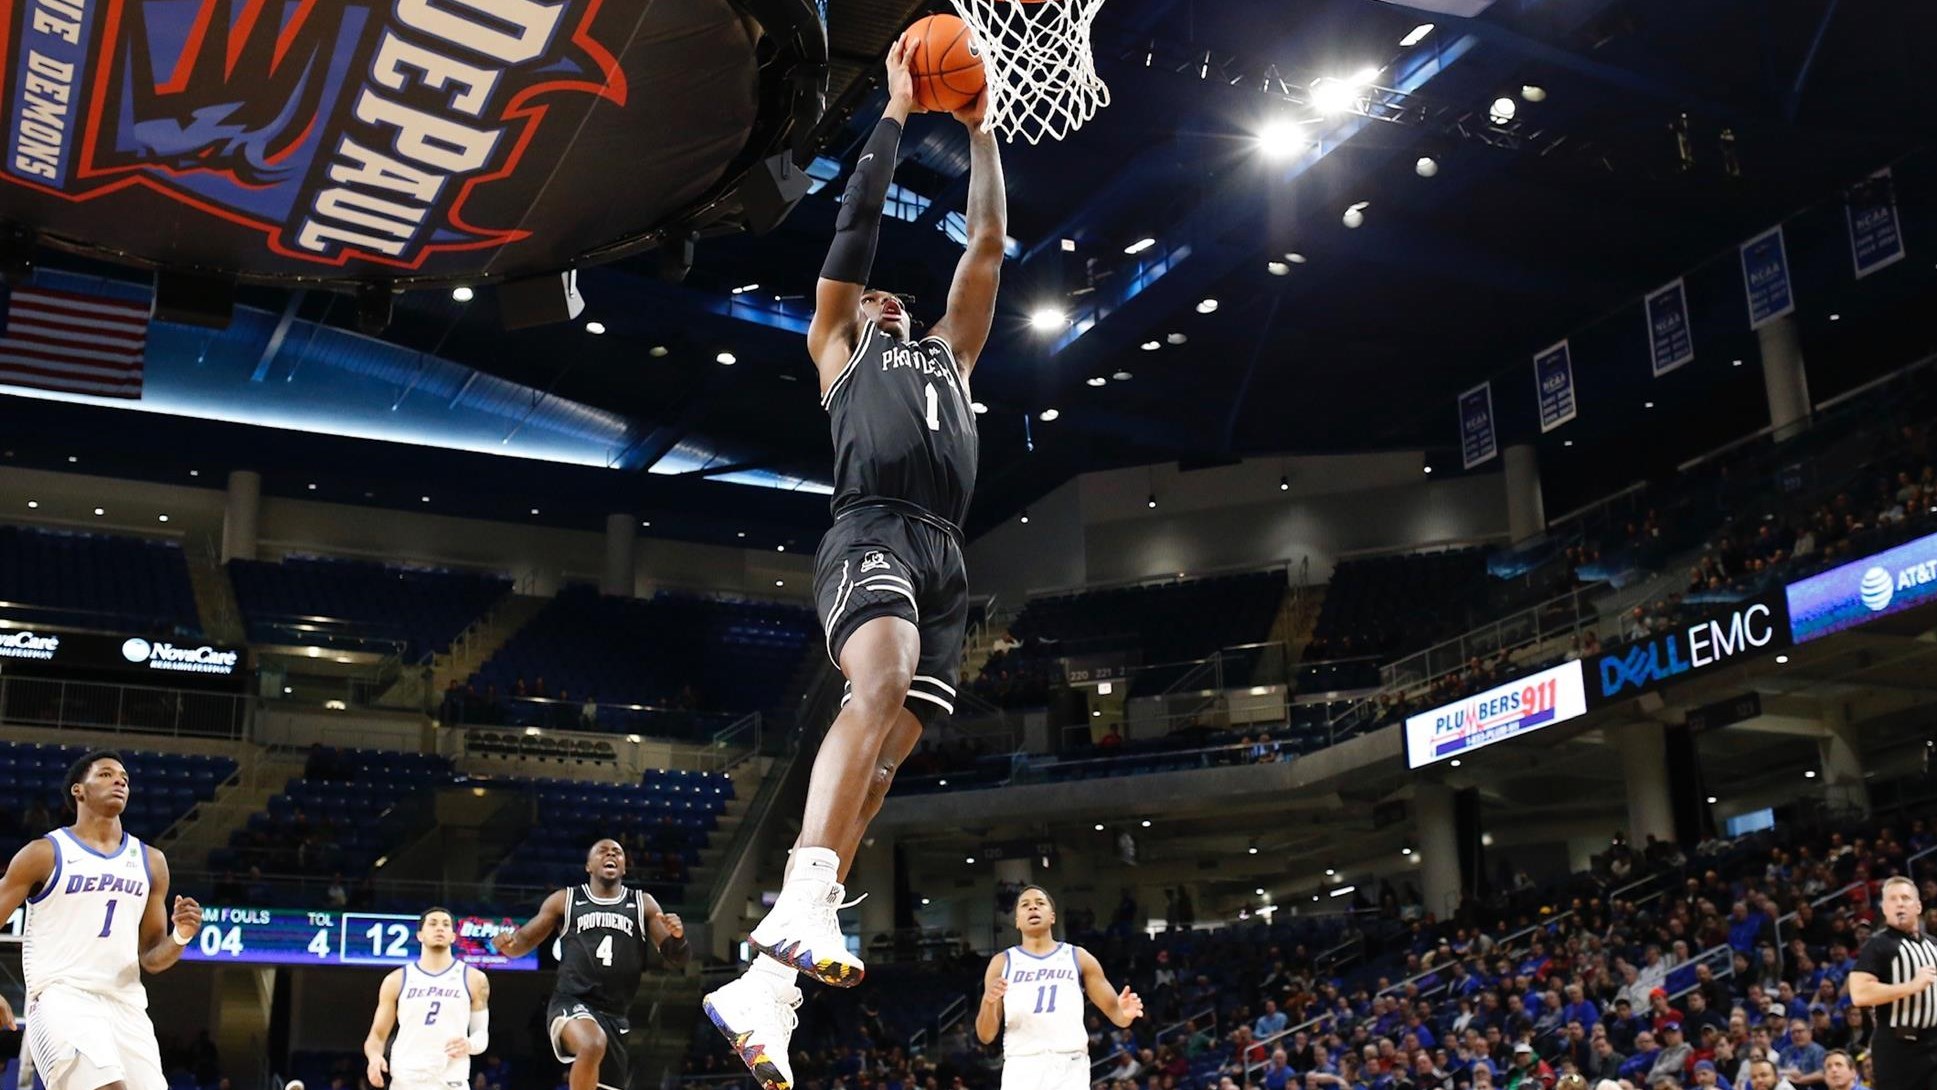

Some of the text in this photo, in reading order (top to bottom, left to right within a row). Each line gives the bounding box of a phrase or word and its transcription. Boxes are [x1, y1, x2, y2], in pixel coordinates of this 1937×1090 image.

[16, 0, 85, 180] UE DEMONS
[298, 0, 565, 256] DEPAUL
[1855, 207, 1888, 230] NCAA
[1750, 263, 1780, 285] NCAA
[925, 381, 940, 431] 1
[1897, 559, 1937, 591] AT&T
[0, 631, 59, 651] vaCare
[150, 642, 237, 666] NovaCare
[98, 899, 118, 938] 1
[201, 908, 334, 928] AM FOULS TOL
[576, 911, 634, 937] PROVIDENCE
[200, 924, 331, 959] 04 4
[365, 922, 410, 957] 12
[595, 935, 613, 967] 4
[424, 1001, 441, 1026] 2
[1033, 984, 1058, 1014] 11
